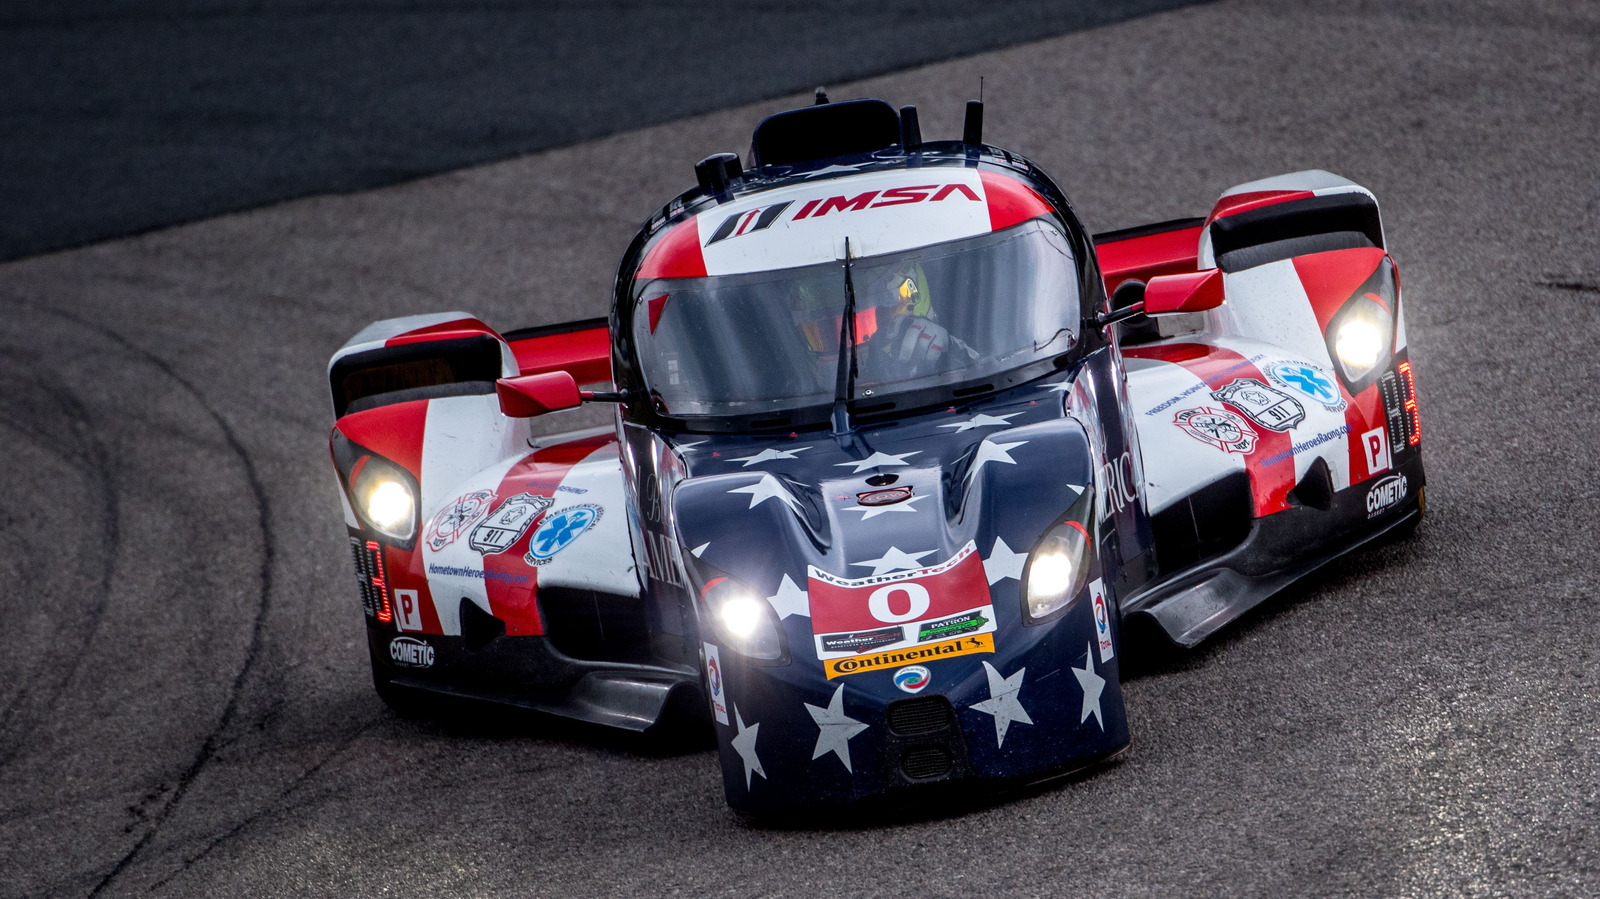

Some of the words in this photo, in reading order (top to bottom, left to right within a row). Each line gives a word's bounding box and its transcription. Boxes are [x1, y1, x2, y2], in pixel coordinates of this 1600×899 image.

[791, 183, 983, 222] IMSA
[1268, 405, 1291, 421] 911
[1260, 423, 1354, 469] HometownHeroesRacing.com
[1368, 434, 1382, 468] P
[1366, 475, 1408, 513] COMETIC
[483, 529, 505, 544] 911
[428, 562, 529, 585] HometownHeroesRacing.com
[814, 546, 972, 586] WeatherTech
[401, 593, 414, 626] P
[390, 640, 435, 666] COMETIC
[833, 640, 964, 674] Continental
